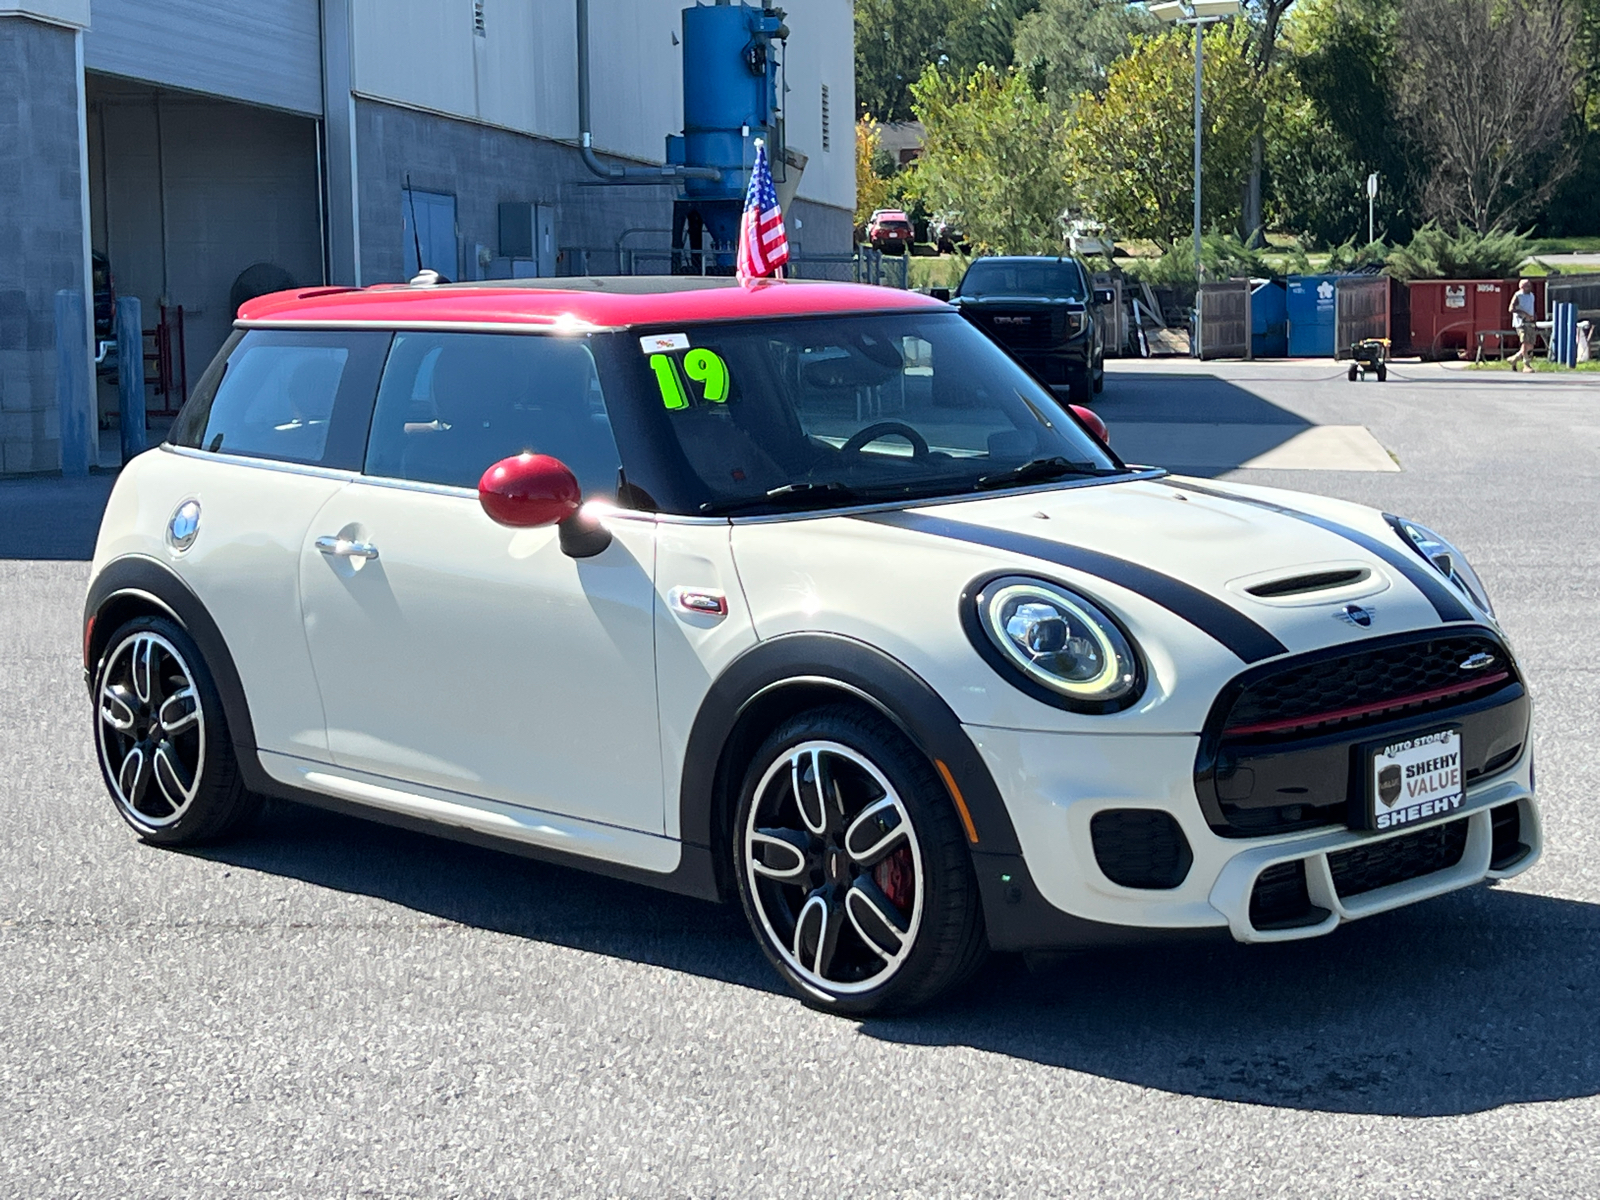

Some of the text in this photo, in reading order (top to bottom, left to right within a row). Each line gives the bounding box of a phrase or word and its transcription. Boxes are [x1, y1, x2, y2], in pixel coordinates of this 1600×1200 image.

[650, 348, 730, 410] 19
[1383, 741, 1412, 756] AUTO
[1406, 752, 1458, 778] SHEEHY
[1406, 768, 1459, 798] VALUE
[1377, 793, 1463, 829] SHEEHY
